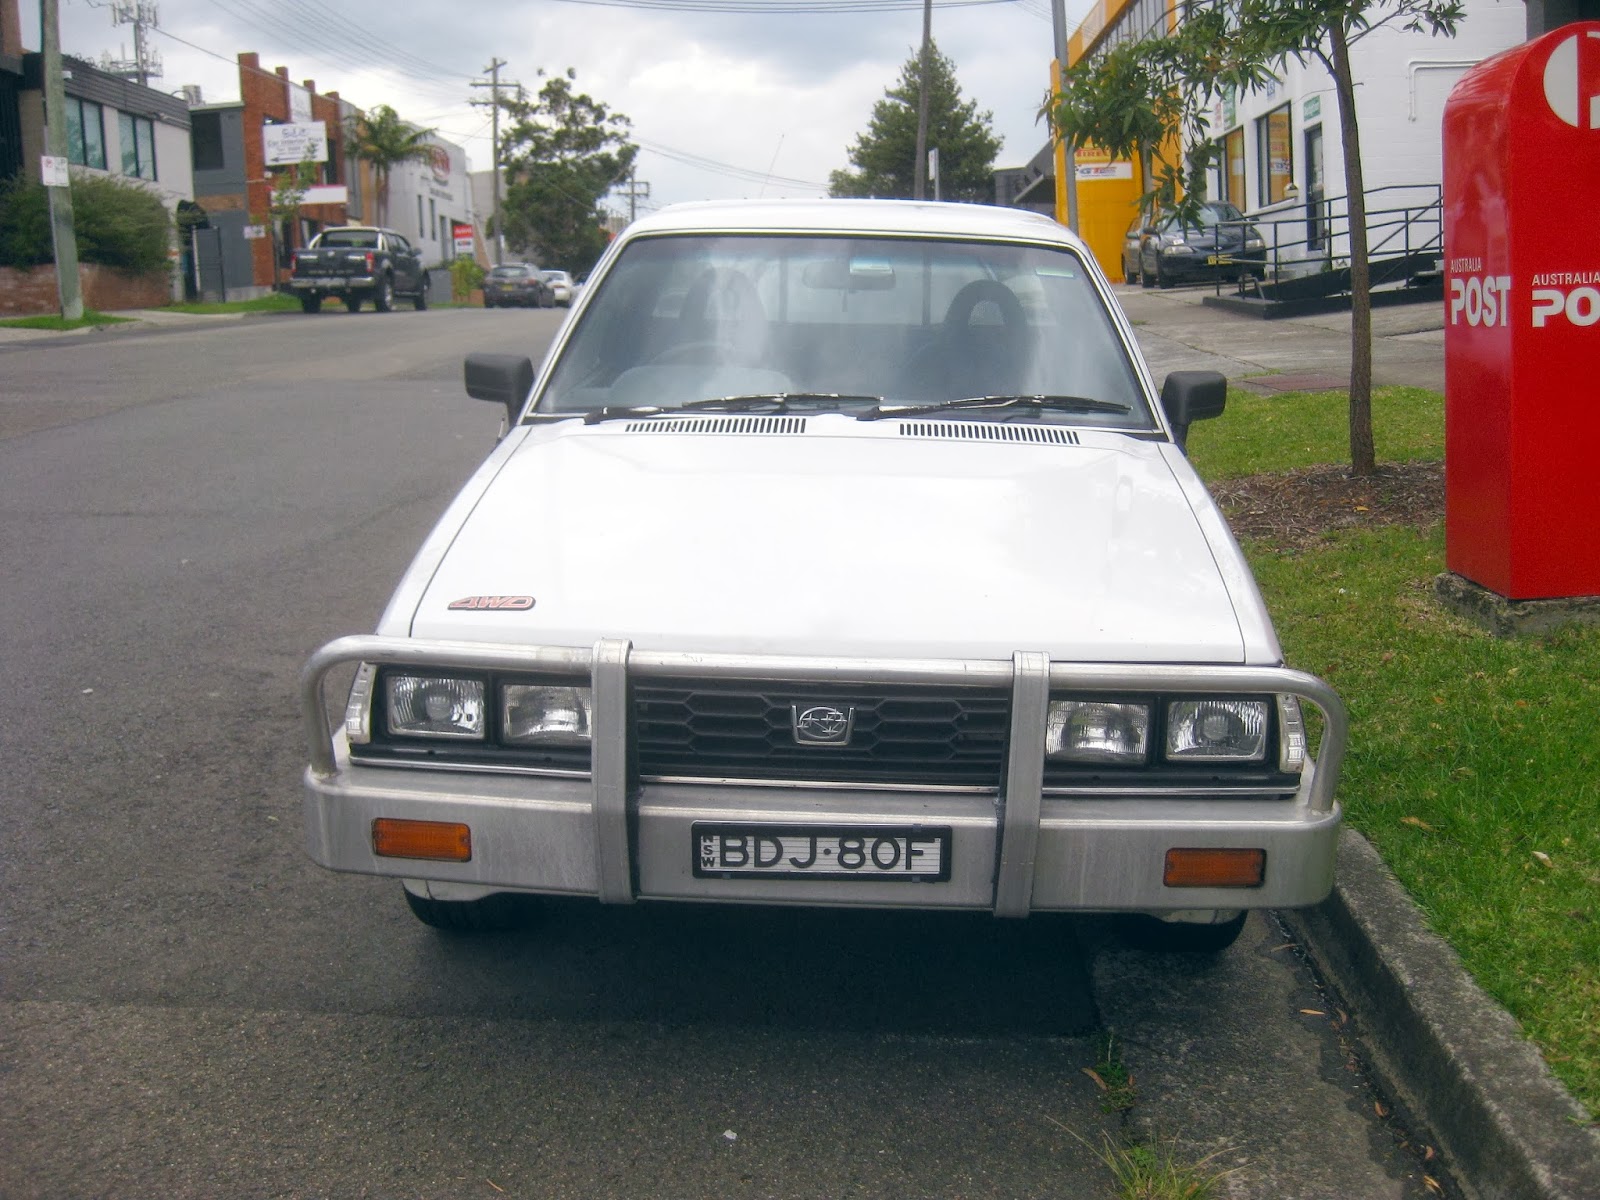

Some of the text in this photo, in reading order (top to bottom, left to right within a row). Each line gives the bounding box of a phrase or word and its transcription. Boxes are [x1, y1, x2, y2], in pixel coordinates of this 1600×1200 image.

[1450, 257, 1481, 273] AUSTRALIA
[1532, 271, 1600, 286] AUSTRALIA
[1451, 276, 1511, 327] POST
[447, 595, 536, 611] 4WD
